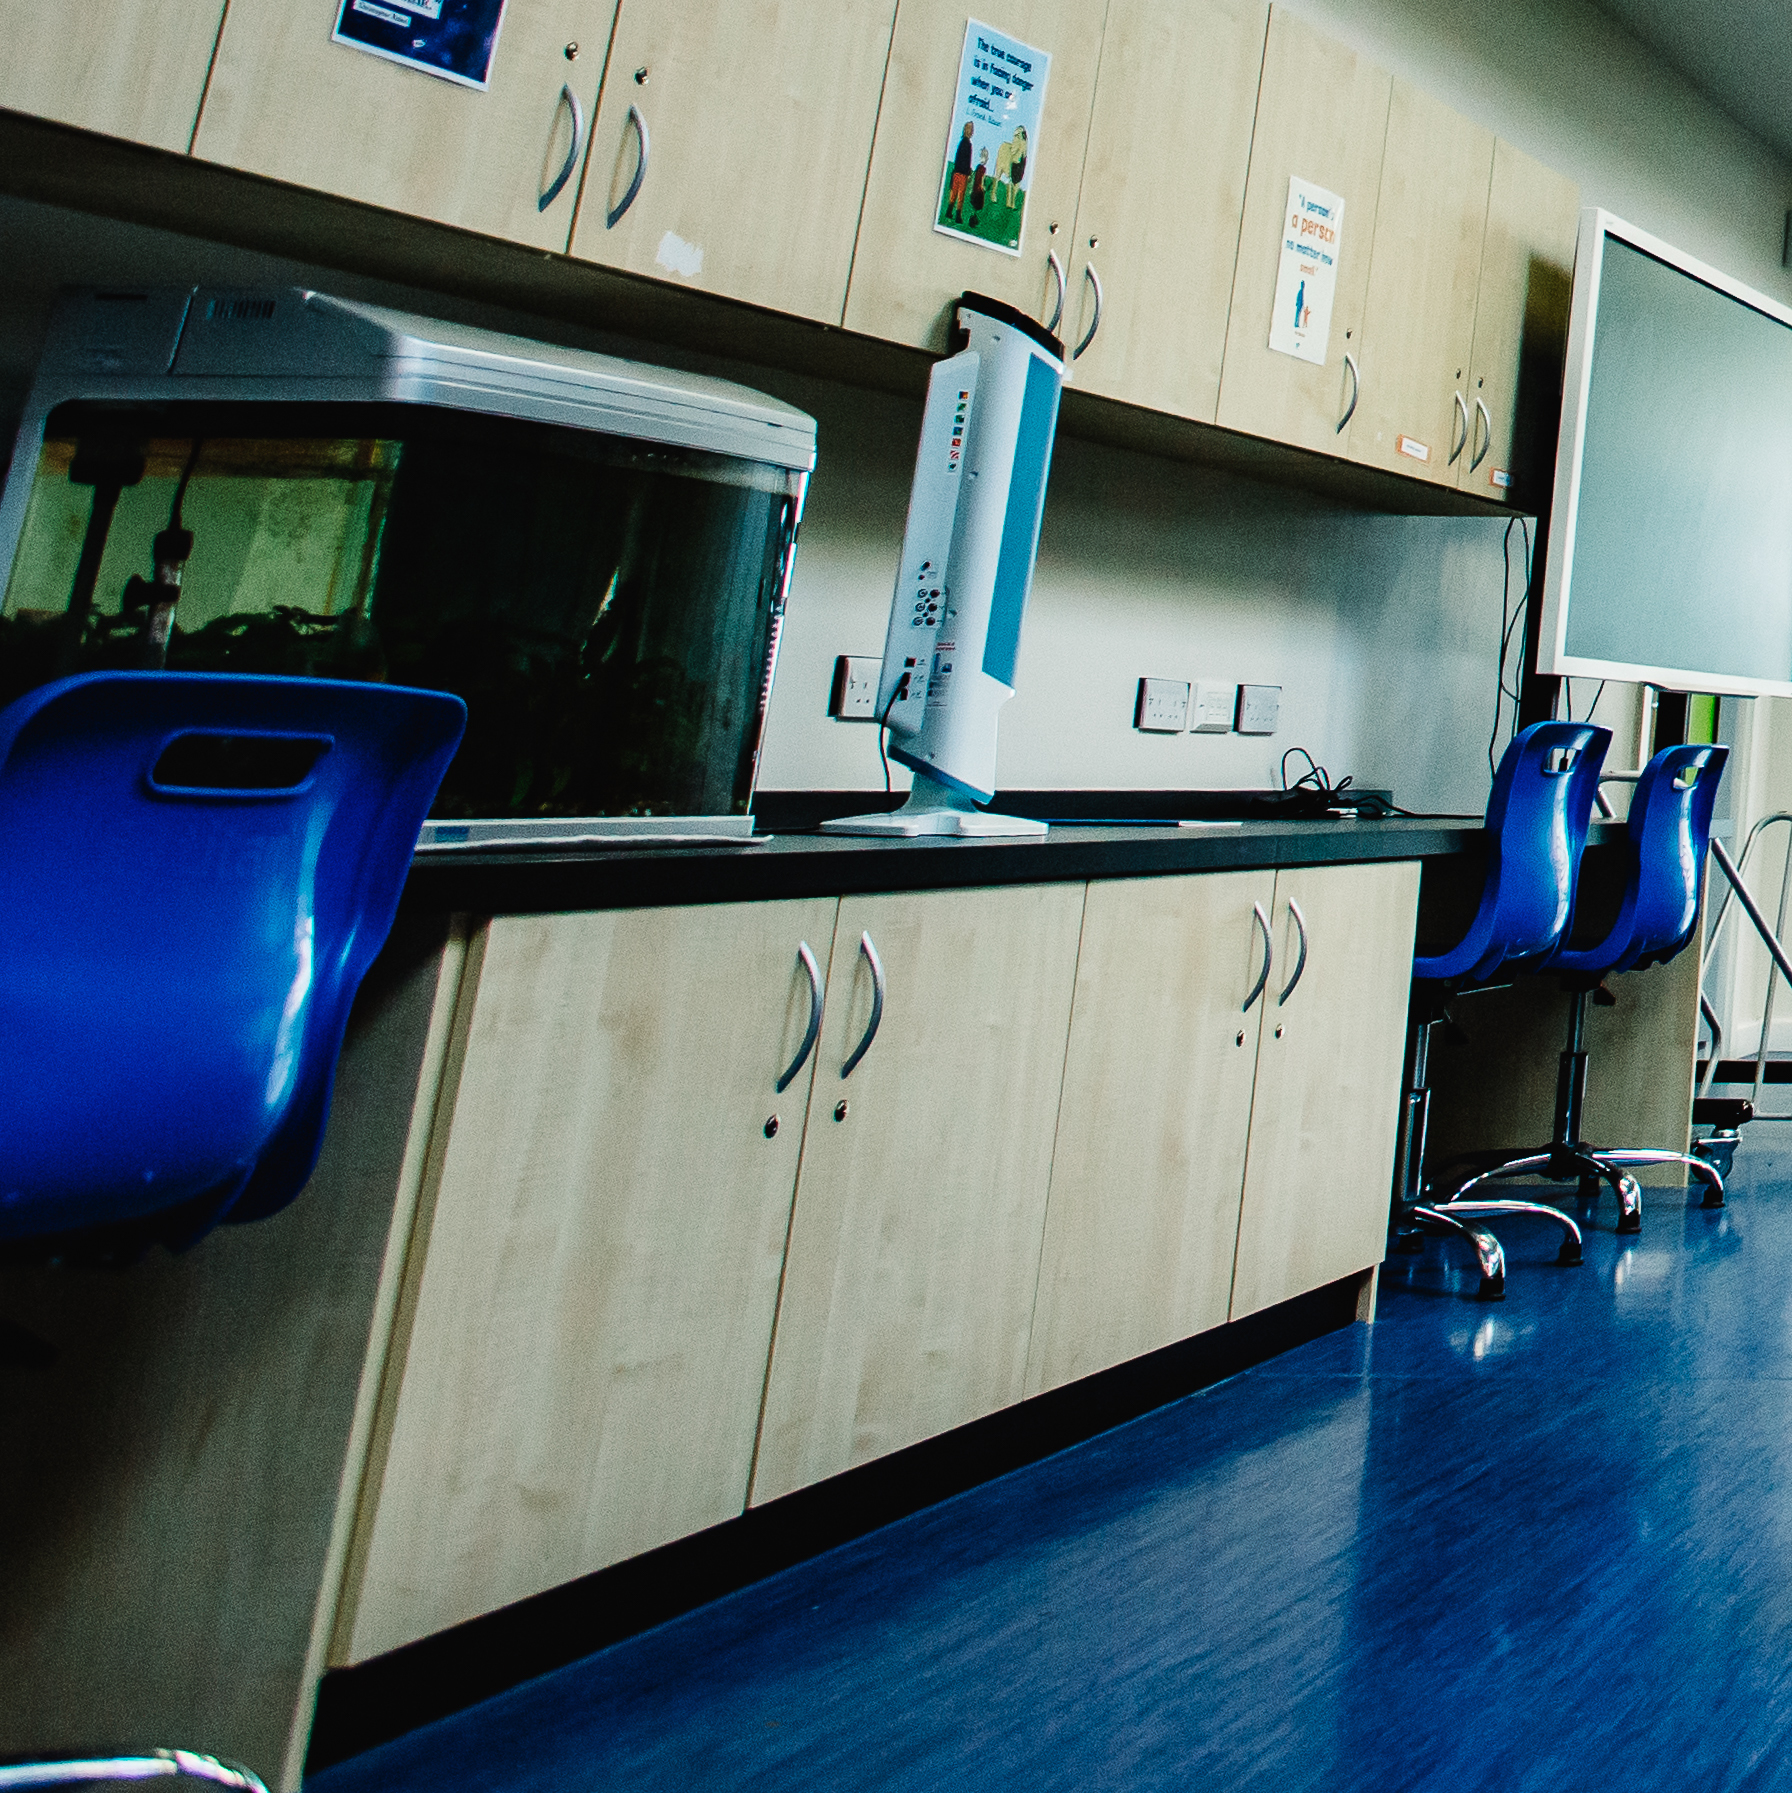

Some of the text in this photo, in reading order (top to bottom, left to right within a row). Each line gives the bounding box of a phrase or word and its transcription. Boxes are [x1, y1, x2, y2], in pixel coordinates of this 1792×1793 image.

[977, 37, 990, 53] The
[1006, 53, 1032, 73] courage
[973, 55, 1034, 92] is in facing danger
[971, 76, 990, 90] when
[990, 85, 1004, 97] you
[1291, 214, 1298, 228] a
[1296, 243, 1321, 260] matter
